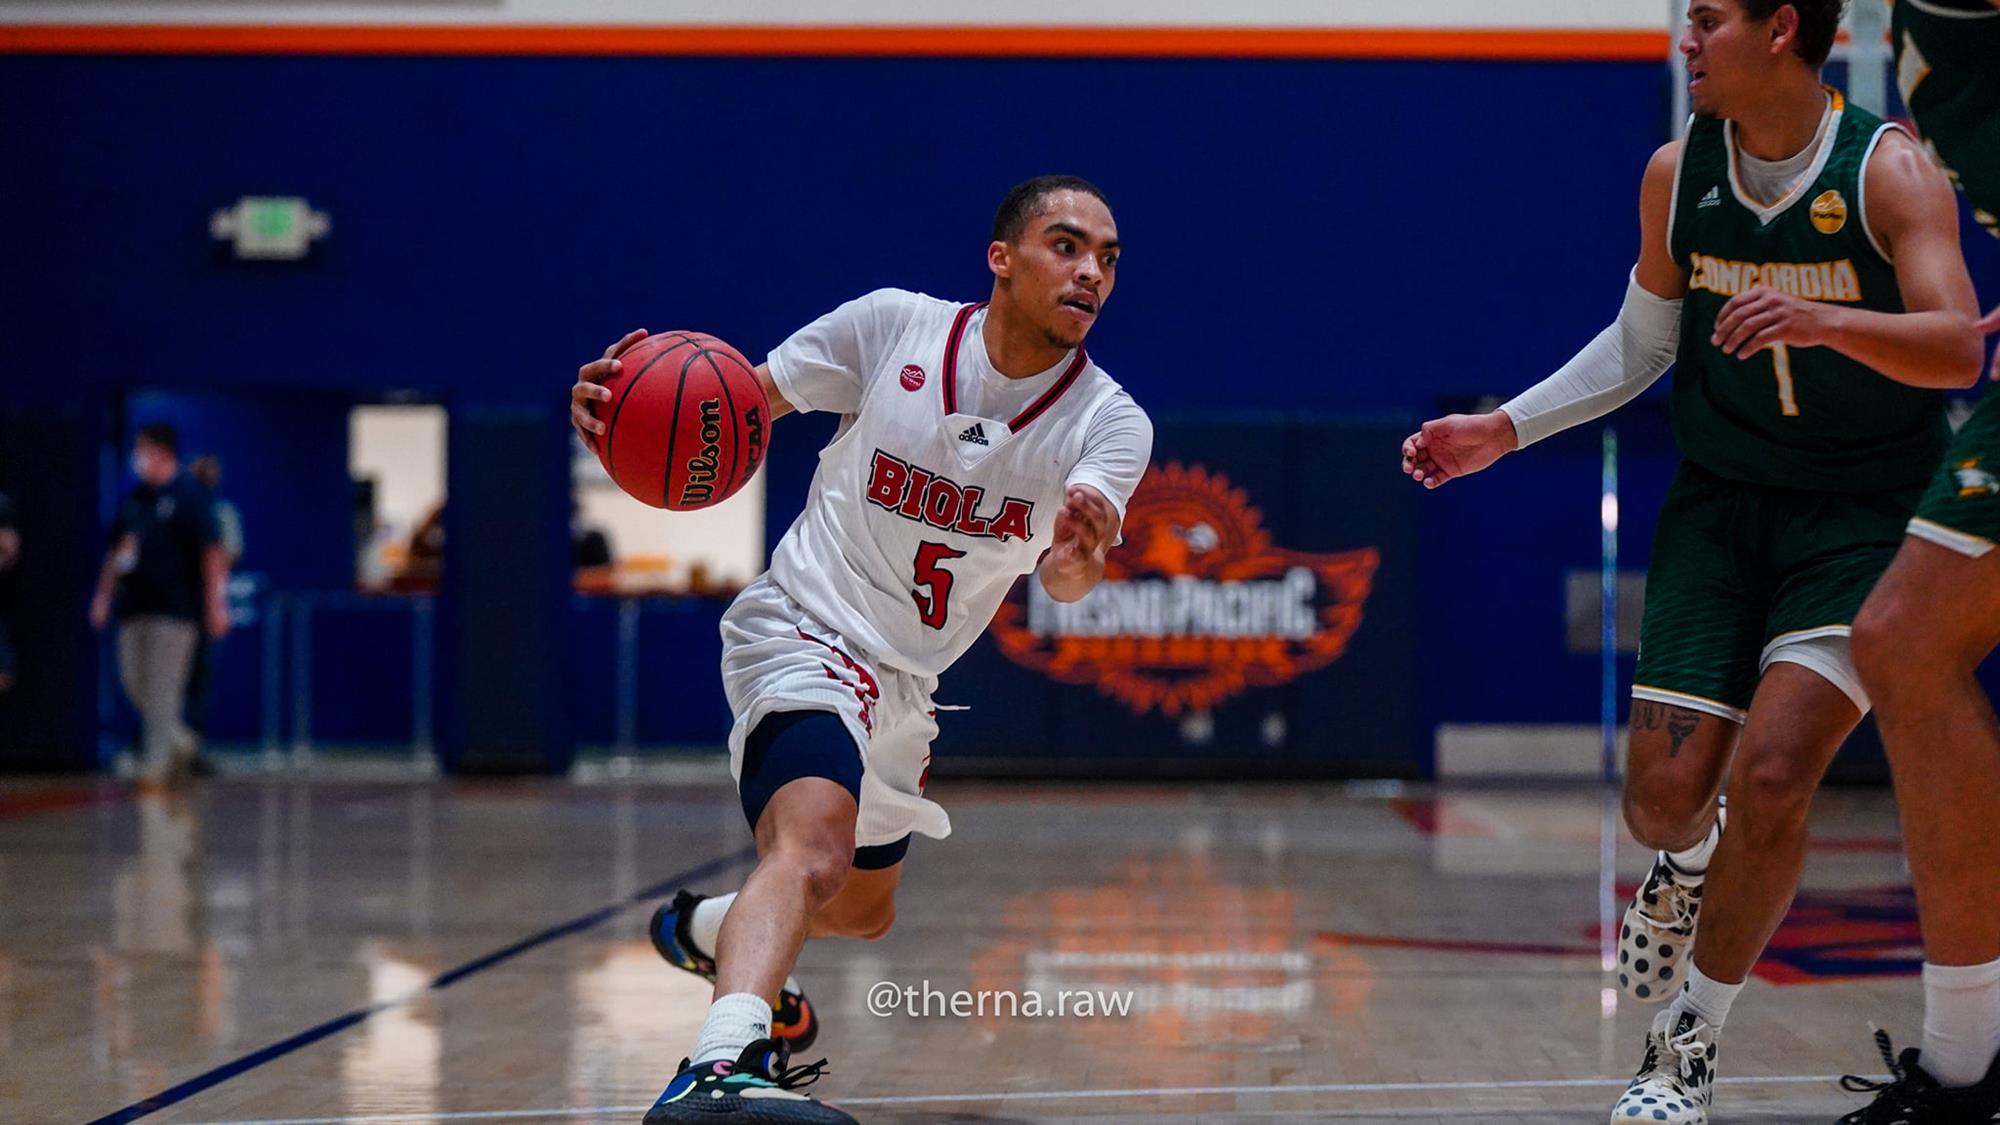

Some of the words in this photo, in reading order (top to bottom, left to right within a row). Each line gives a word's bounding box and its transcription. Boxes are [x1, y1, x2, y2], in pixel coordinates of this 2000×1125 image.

[1689, 252, 1862, 301] CONCORDIA
[680, 397, 722, 506] Wilson
[958, 433, 989, 446] adidas
[866, 448, 1034, 542] BIOLA
[911, 540, 967, 630] 5
